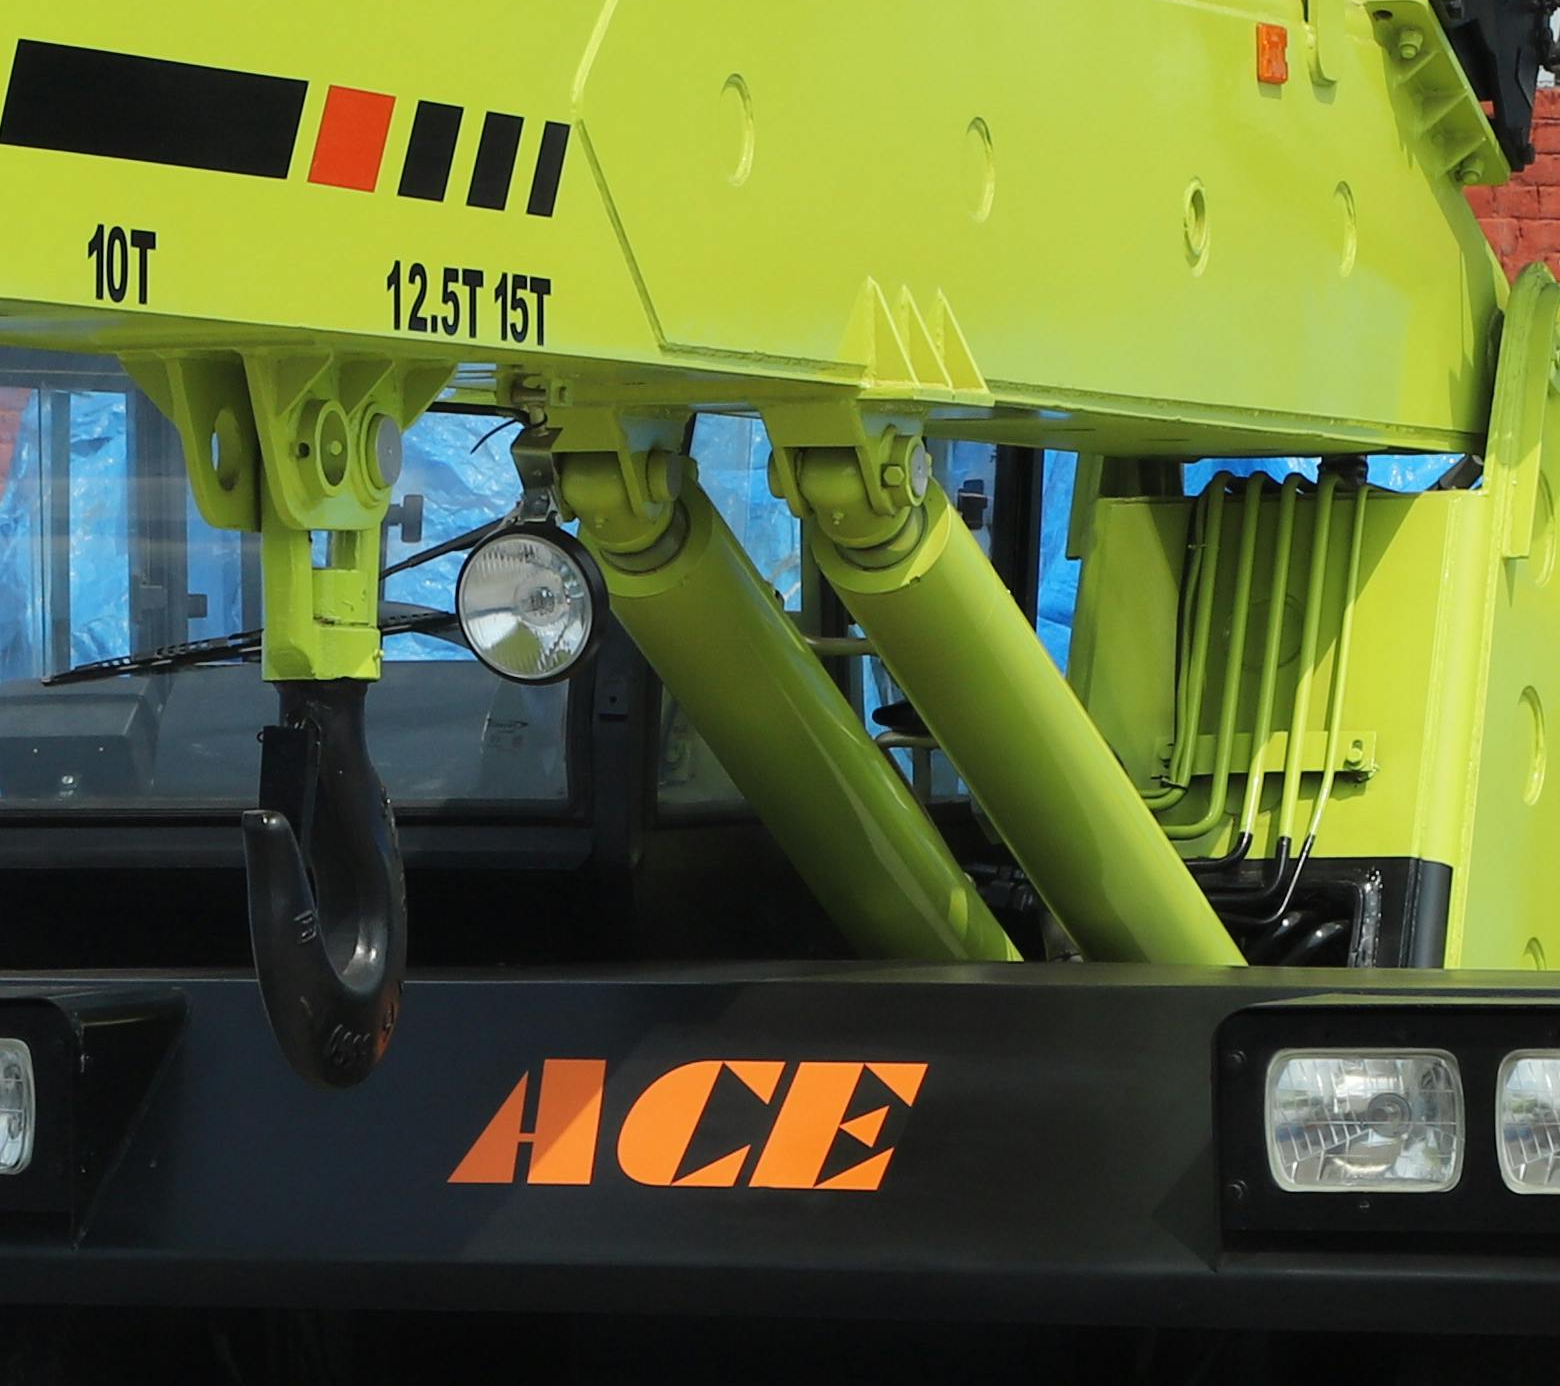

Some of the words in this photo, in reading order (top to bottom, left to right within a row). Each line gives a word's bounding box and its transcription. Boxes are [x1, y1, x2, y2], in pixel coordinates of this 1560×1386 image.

[87, 224, 156, 305] 10T
[386, 260, 483, 339] 12.5T
[494, 272, 551, 346] 15T
[447, 1059, 928, 1190] ACE
